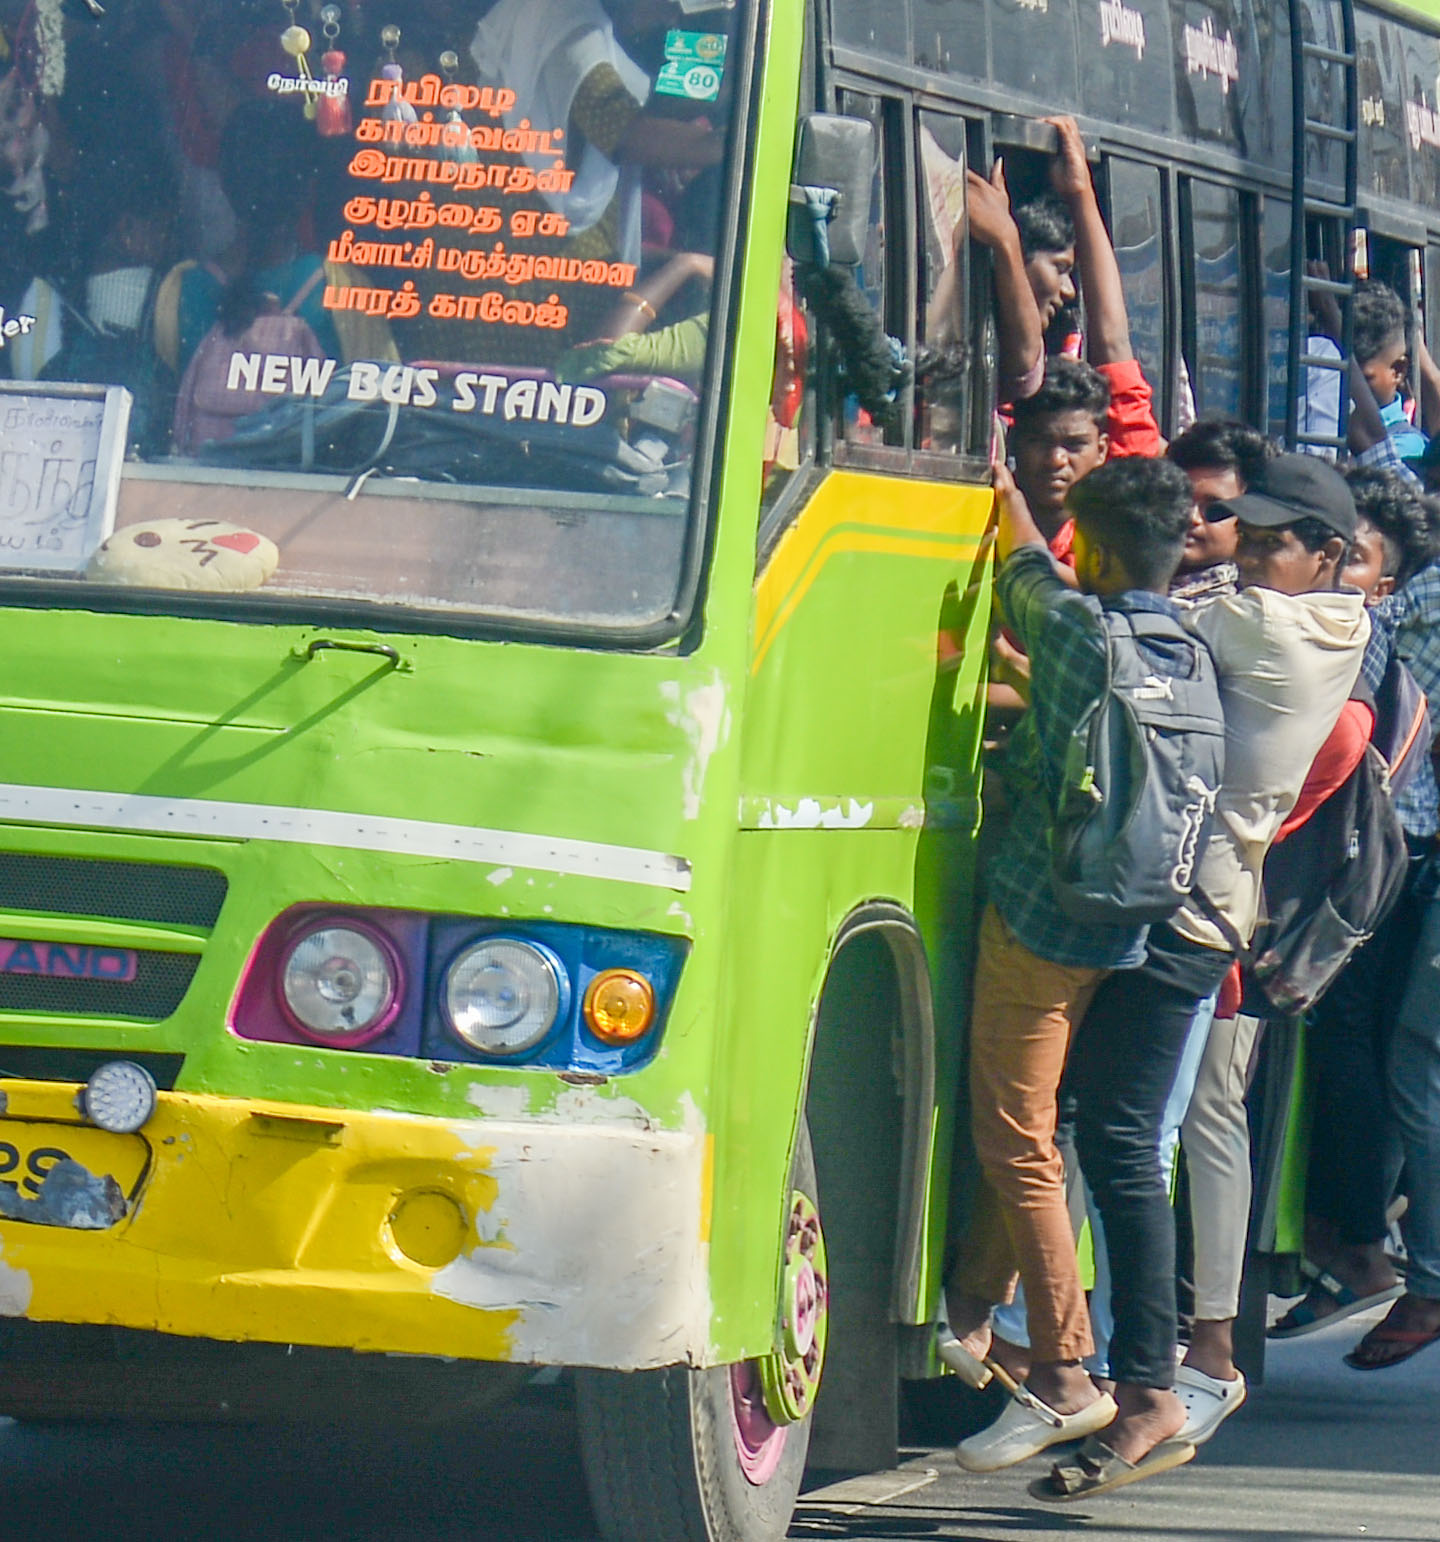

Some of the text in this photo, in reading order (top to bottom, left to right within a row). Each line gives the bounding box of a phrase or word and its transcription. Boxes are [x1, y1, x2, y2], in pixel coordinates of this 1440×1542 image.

[689, 72, 714, 88] 80
[348, 149, 575, 194] இராமநாதன்
[343, 191, 571, 238] குழந்தை ஏசு
[327, 230, 637, 288] மீனாட்சி மருத்துவமனை
[322, 280, 569, 329] பாரத் காலேஜ்
[226, 351, 607, 427] NEW BUS STAND
